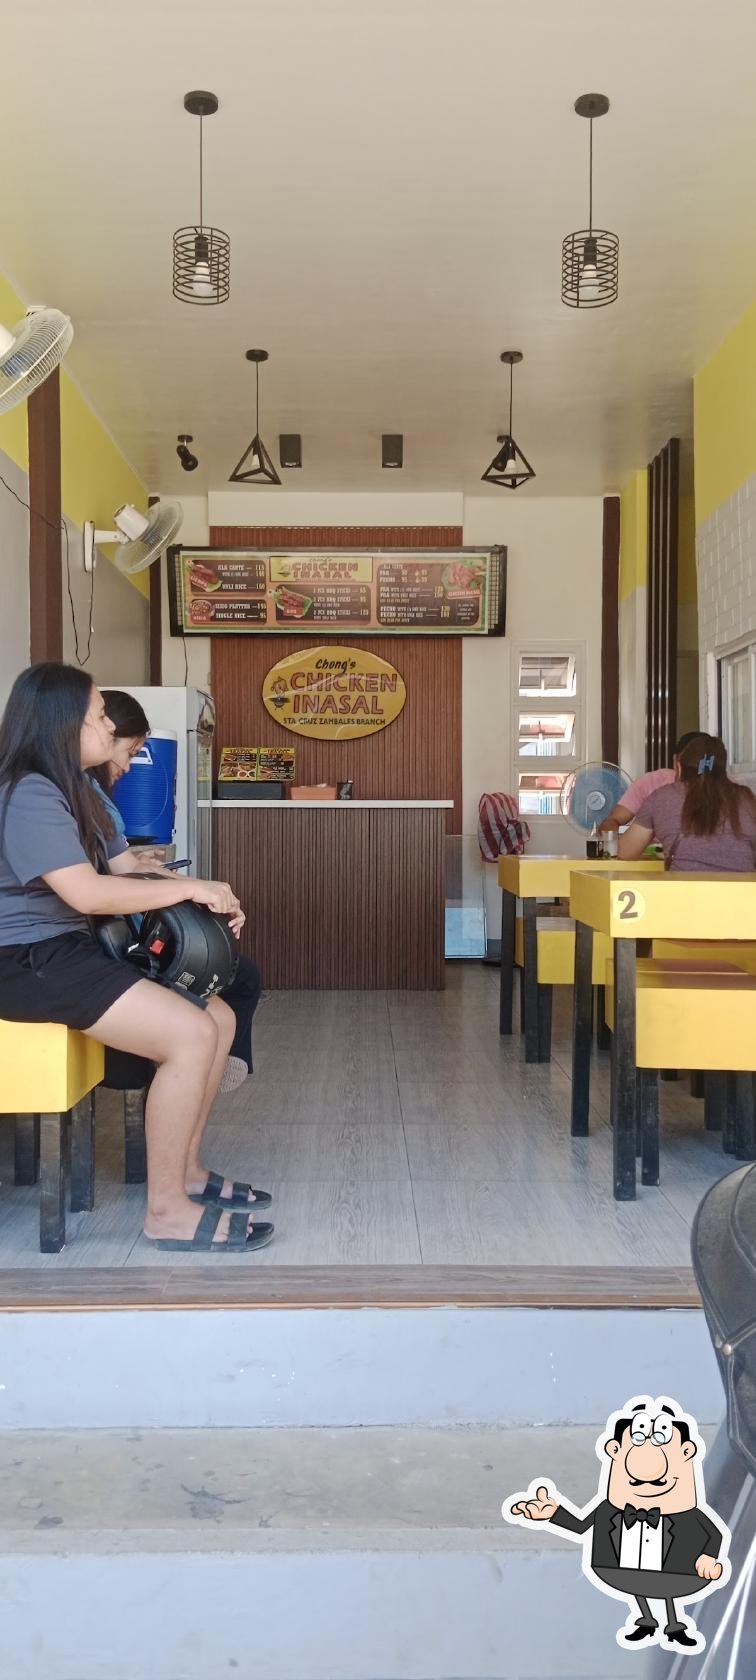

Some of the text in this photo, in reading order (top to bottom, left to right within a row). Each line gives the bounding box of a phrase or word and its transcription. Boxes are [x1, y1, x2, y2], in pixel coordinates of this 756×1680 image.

[291, 562, 359, 571] CHICKEN
[315, 658, 356, 675] Chong's
[290, 671, 398, 693] CHICKEN
[293, 695, 384, 715] INASAL
[319, 717, 356, 725] ZAMBALES
[356, 718, 386, 726] BRANCH
[618, 890, 639, 920] 2
